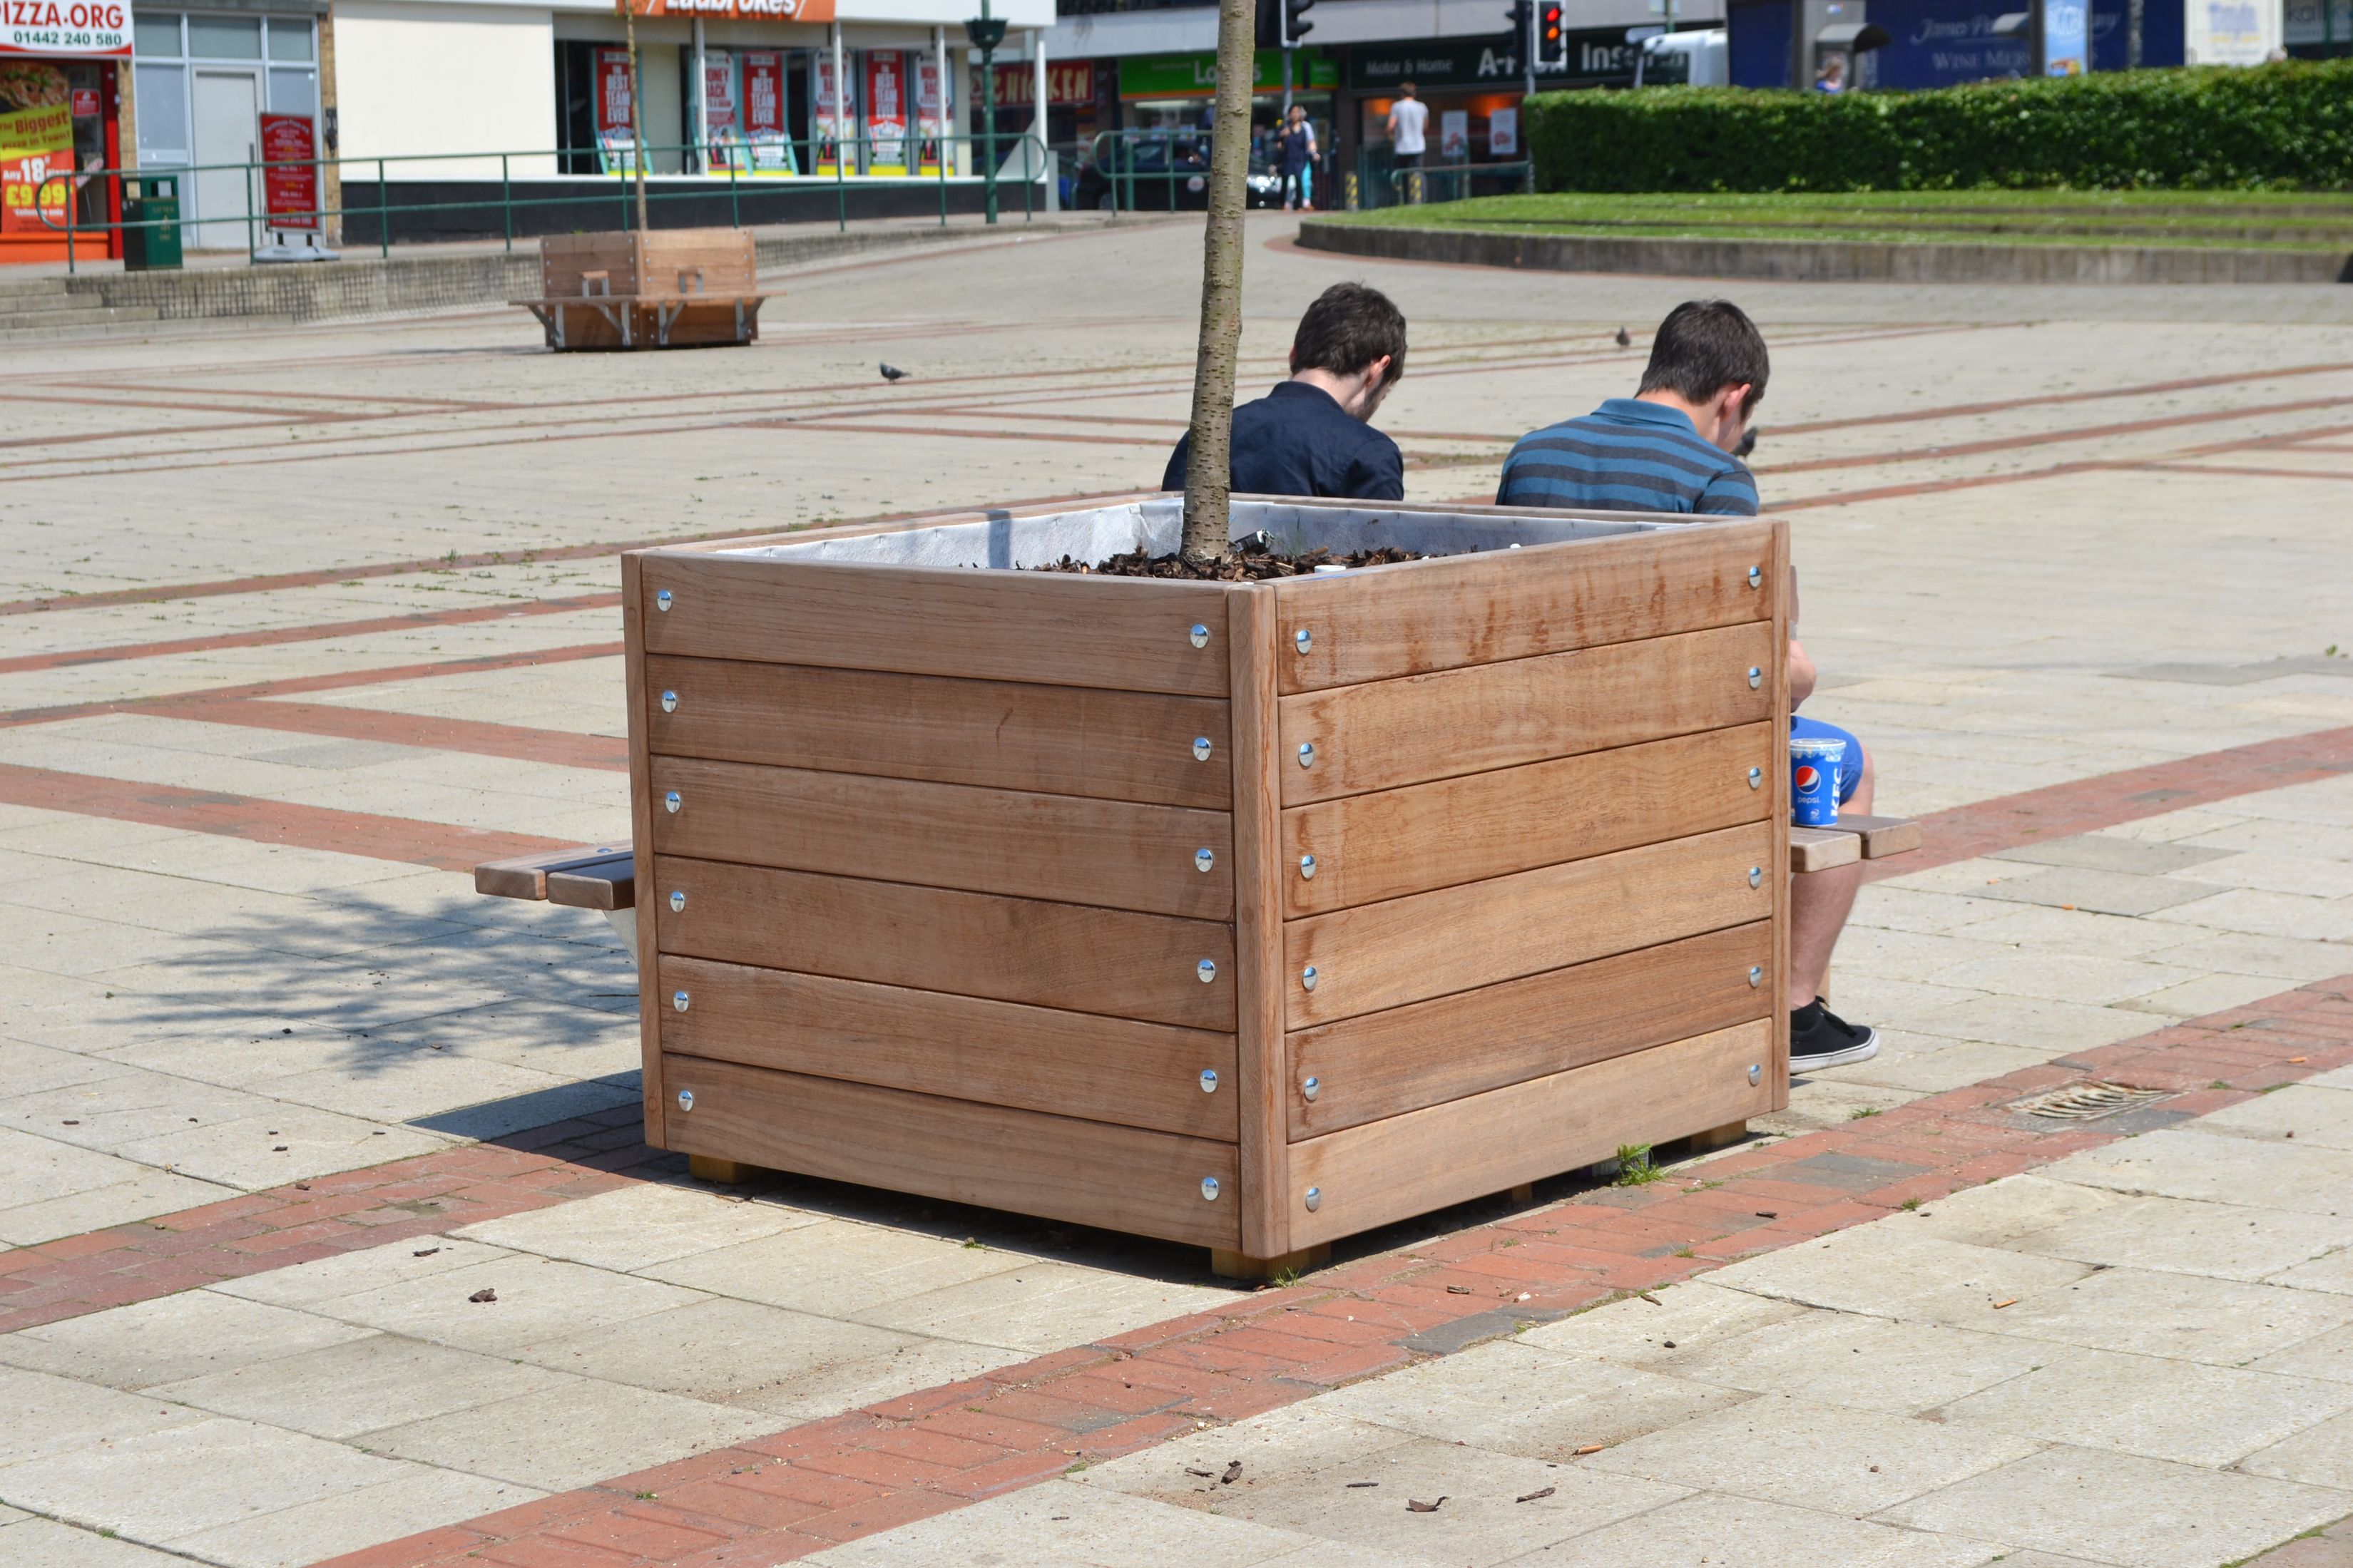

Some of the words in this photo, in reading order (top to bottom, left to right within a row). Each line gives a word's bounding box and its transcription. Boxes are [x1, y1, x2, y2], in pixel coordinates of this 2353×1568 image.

[0, 1, 123, 29] IZZA.ORG
[14, 31, 58, 43] 01442
[65, 33, 90, 45] 240
[96, 34, 121, 46] 580
[1366, 60, 1400, 75] Motor
[1404, 58, 1414, 75] &
[1416, 58, 1453, 72] Home
[606, 74, 628, 91] BEST
[606, 91, 631, 106] TEAM
[16, 110, 68, 134] Biggest
[607, 107, 629, 123] EVER
[29, 137, 39, 145] in
[3, 170, 21, 182] Any
[1830, 767, 1842, 816] KFC
